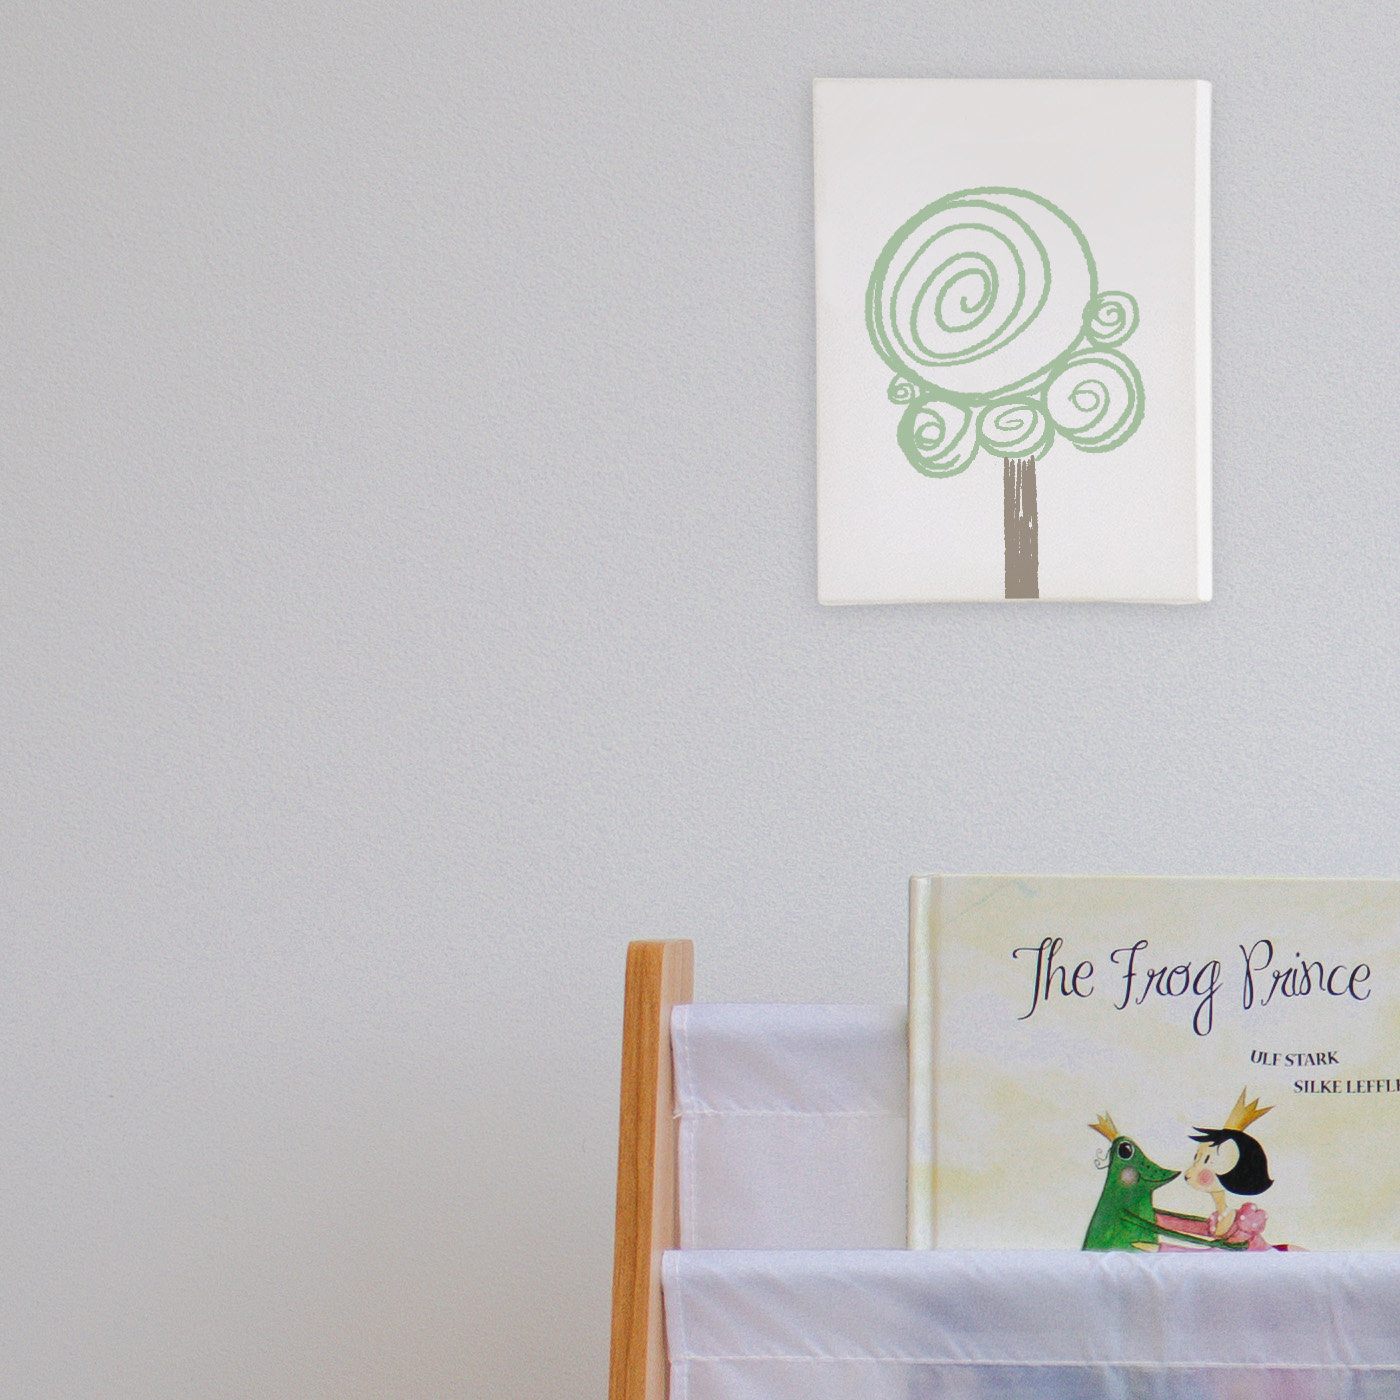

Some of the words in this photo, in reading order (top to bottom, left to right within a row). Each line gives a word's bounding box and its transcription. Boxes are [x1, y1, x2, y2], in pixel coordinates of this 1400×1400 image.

[1012, 936, 1095, 1021] The
[1109, 939, 1225, 1037] Frog
[1239, 939, 1373, 1011] Prince
[1250, 1049, 1282, 1067] ULF
[1284, 1051, 1340, 1067] STARK
[1293, 1079, 1342, 1094] SILKE
